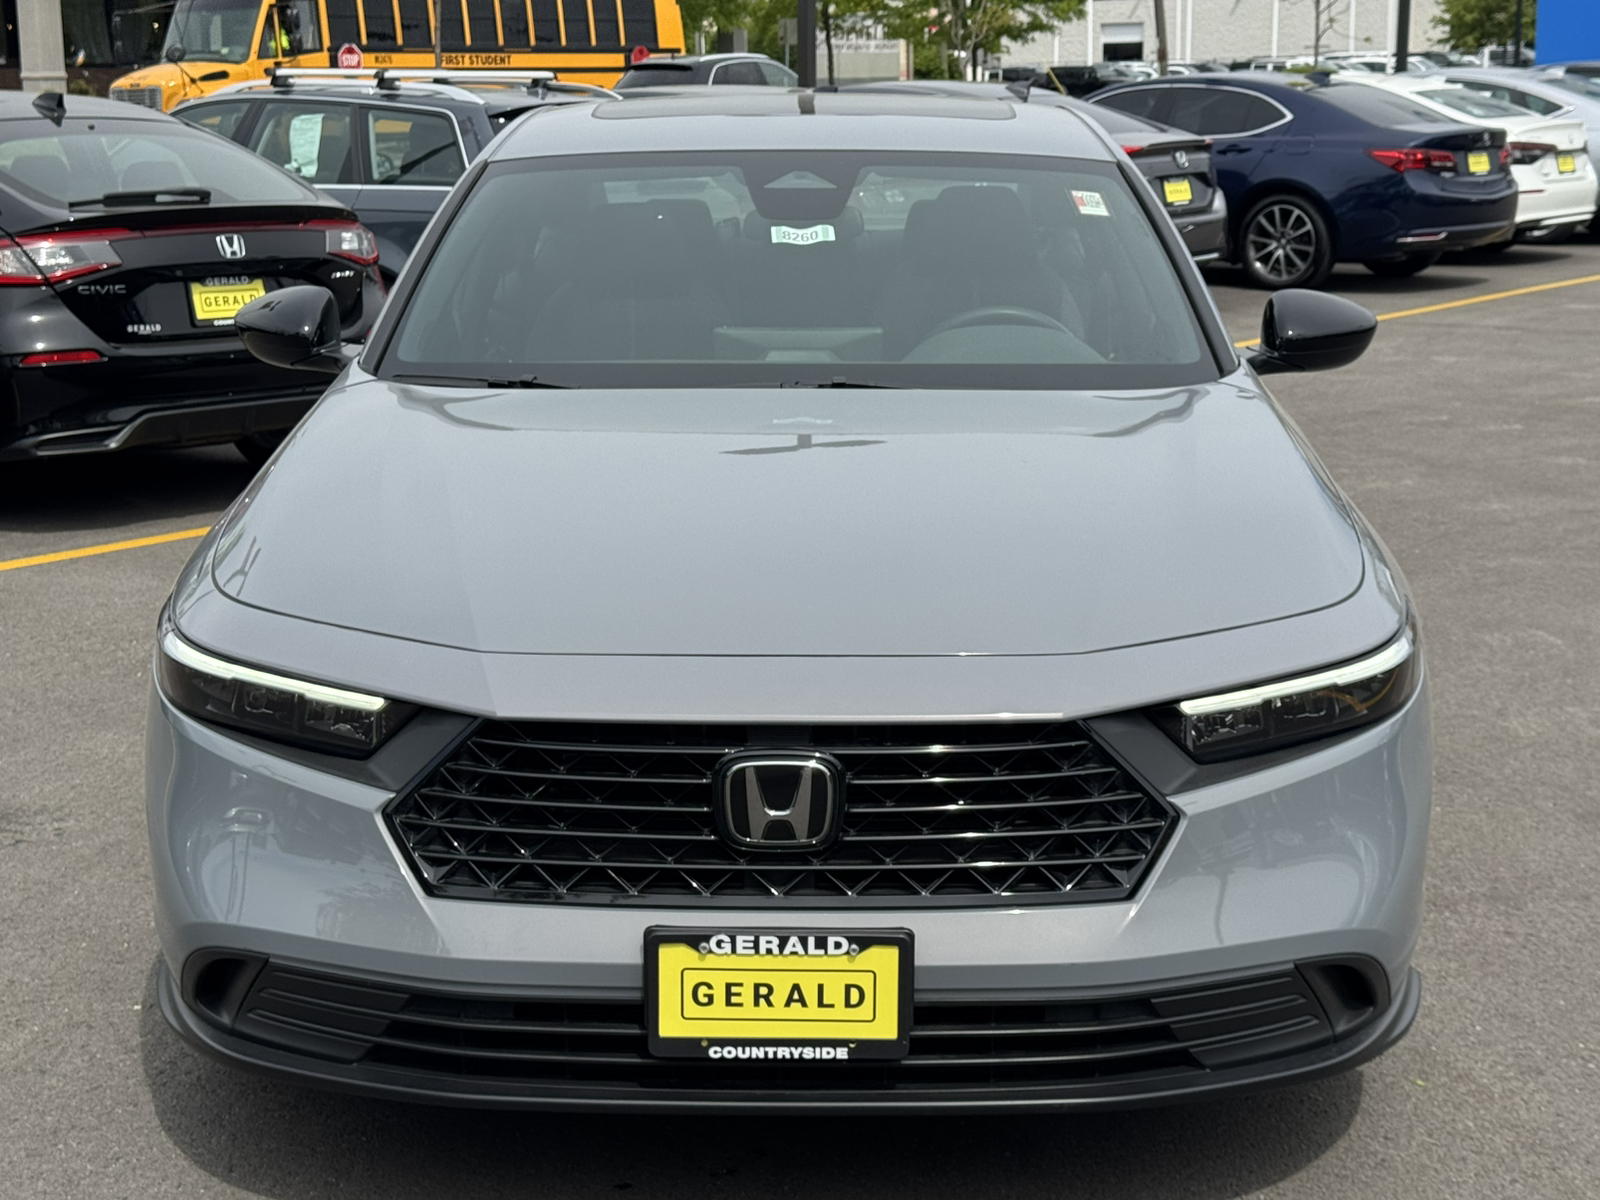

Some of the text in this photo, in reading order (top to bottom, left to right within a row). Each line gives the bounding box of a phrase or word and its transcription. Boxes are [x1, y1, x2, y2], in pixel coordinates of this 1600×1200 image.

[342, 54, 359, 67] STOP
[441, 54, 513, 66] FIRST STUDENT
[782, 230, 819, 243] 8260
[205, 275, 249, 287] GERALD
[77, 284, 127, 295] CIVIC
[204, 293, 257, 308] GERALD
[126, 323, 162, 333] GERALD
[709, 933, 849, 957] GERALD
[691, 981, 866, 1009] GERALD
[708, 1046, 849, 1060] COUNTRYSIDE
